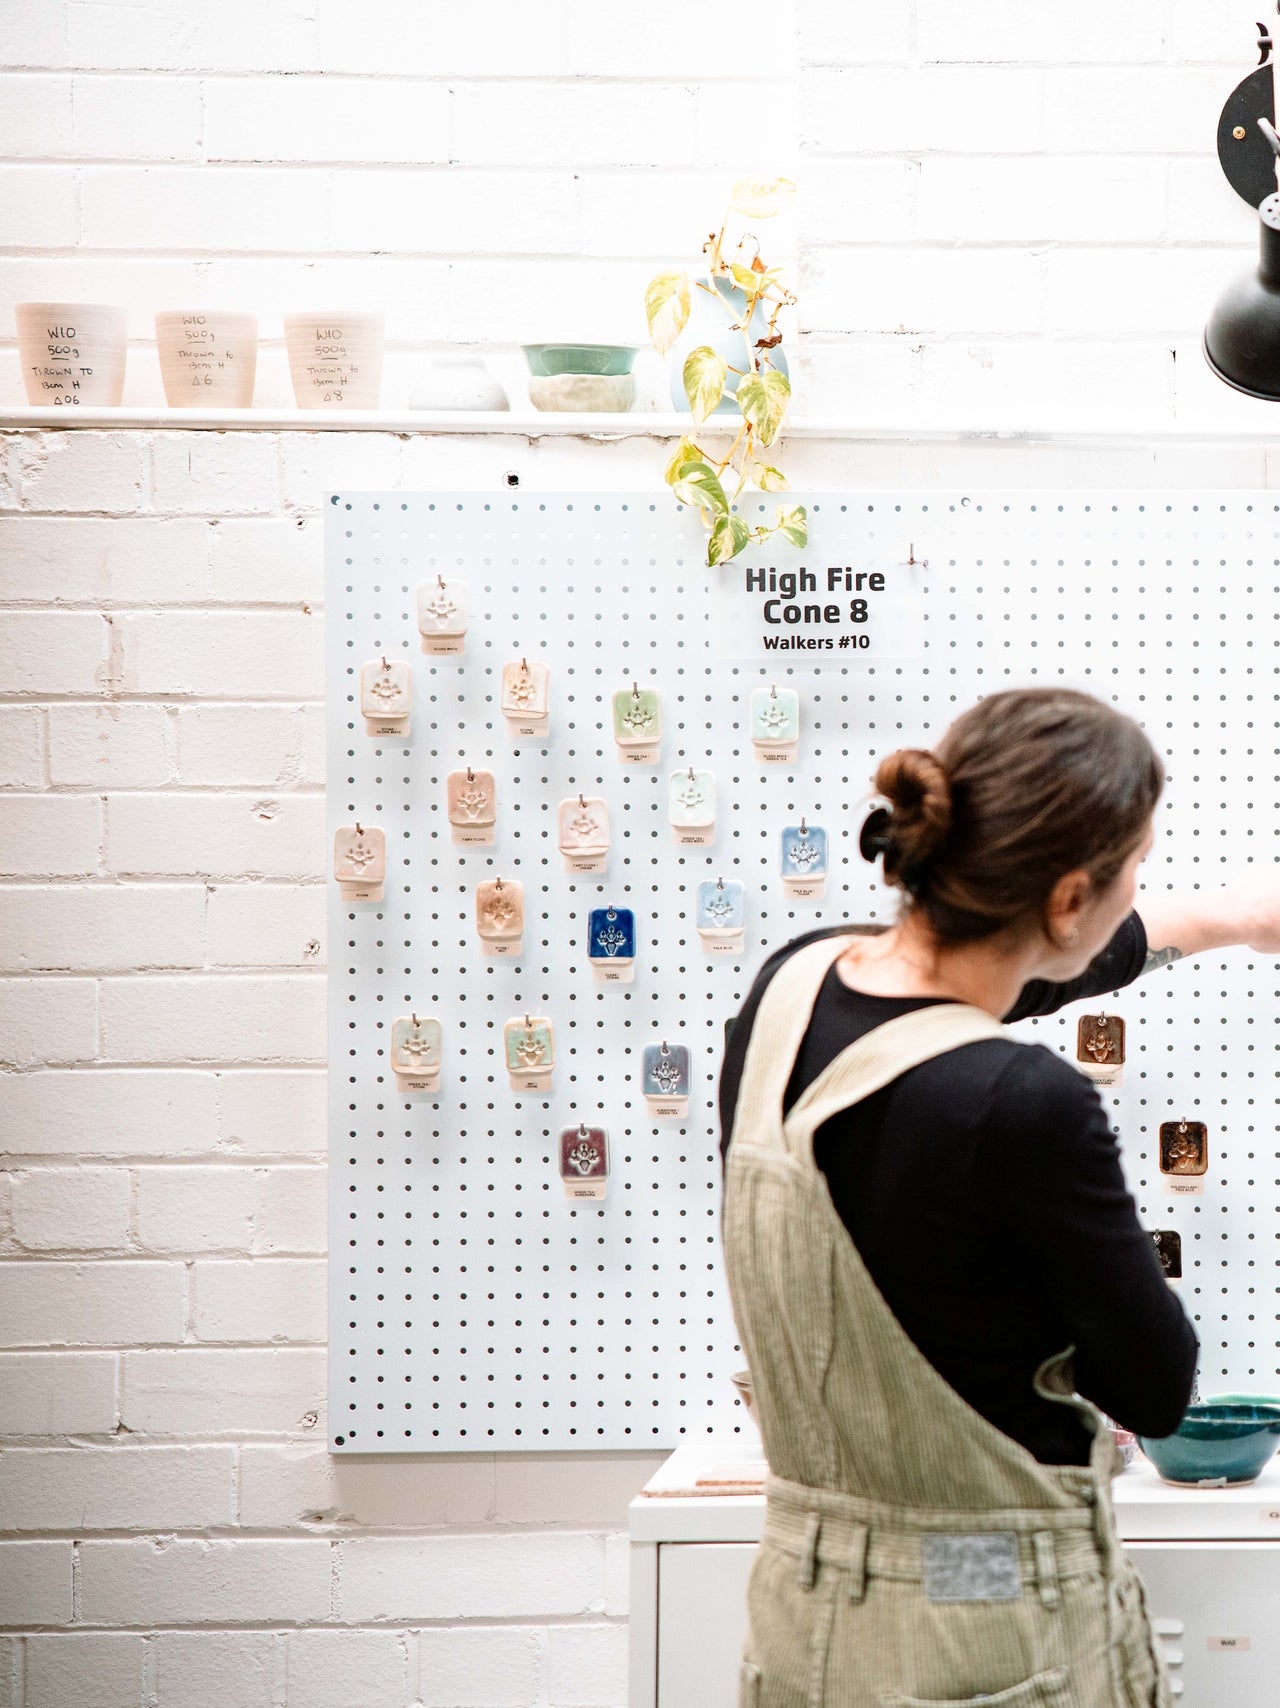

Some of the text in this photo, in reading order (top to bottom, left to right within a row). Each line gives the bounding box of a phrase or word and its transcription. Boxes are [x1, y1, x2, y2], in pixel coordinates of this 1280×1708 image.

[47, 345, 80, 359] 500g
[72, 380, 80, 389] H
[746, 567, 885, 599] High Fire
[763, 598, 868, 624] Cone 8
[763, 634, 870, 650] Walkers #10
